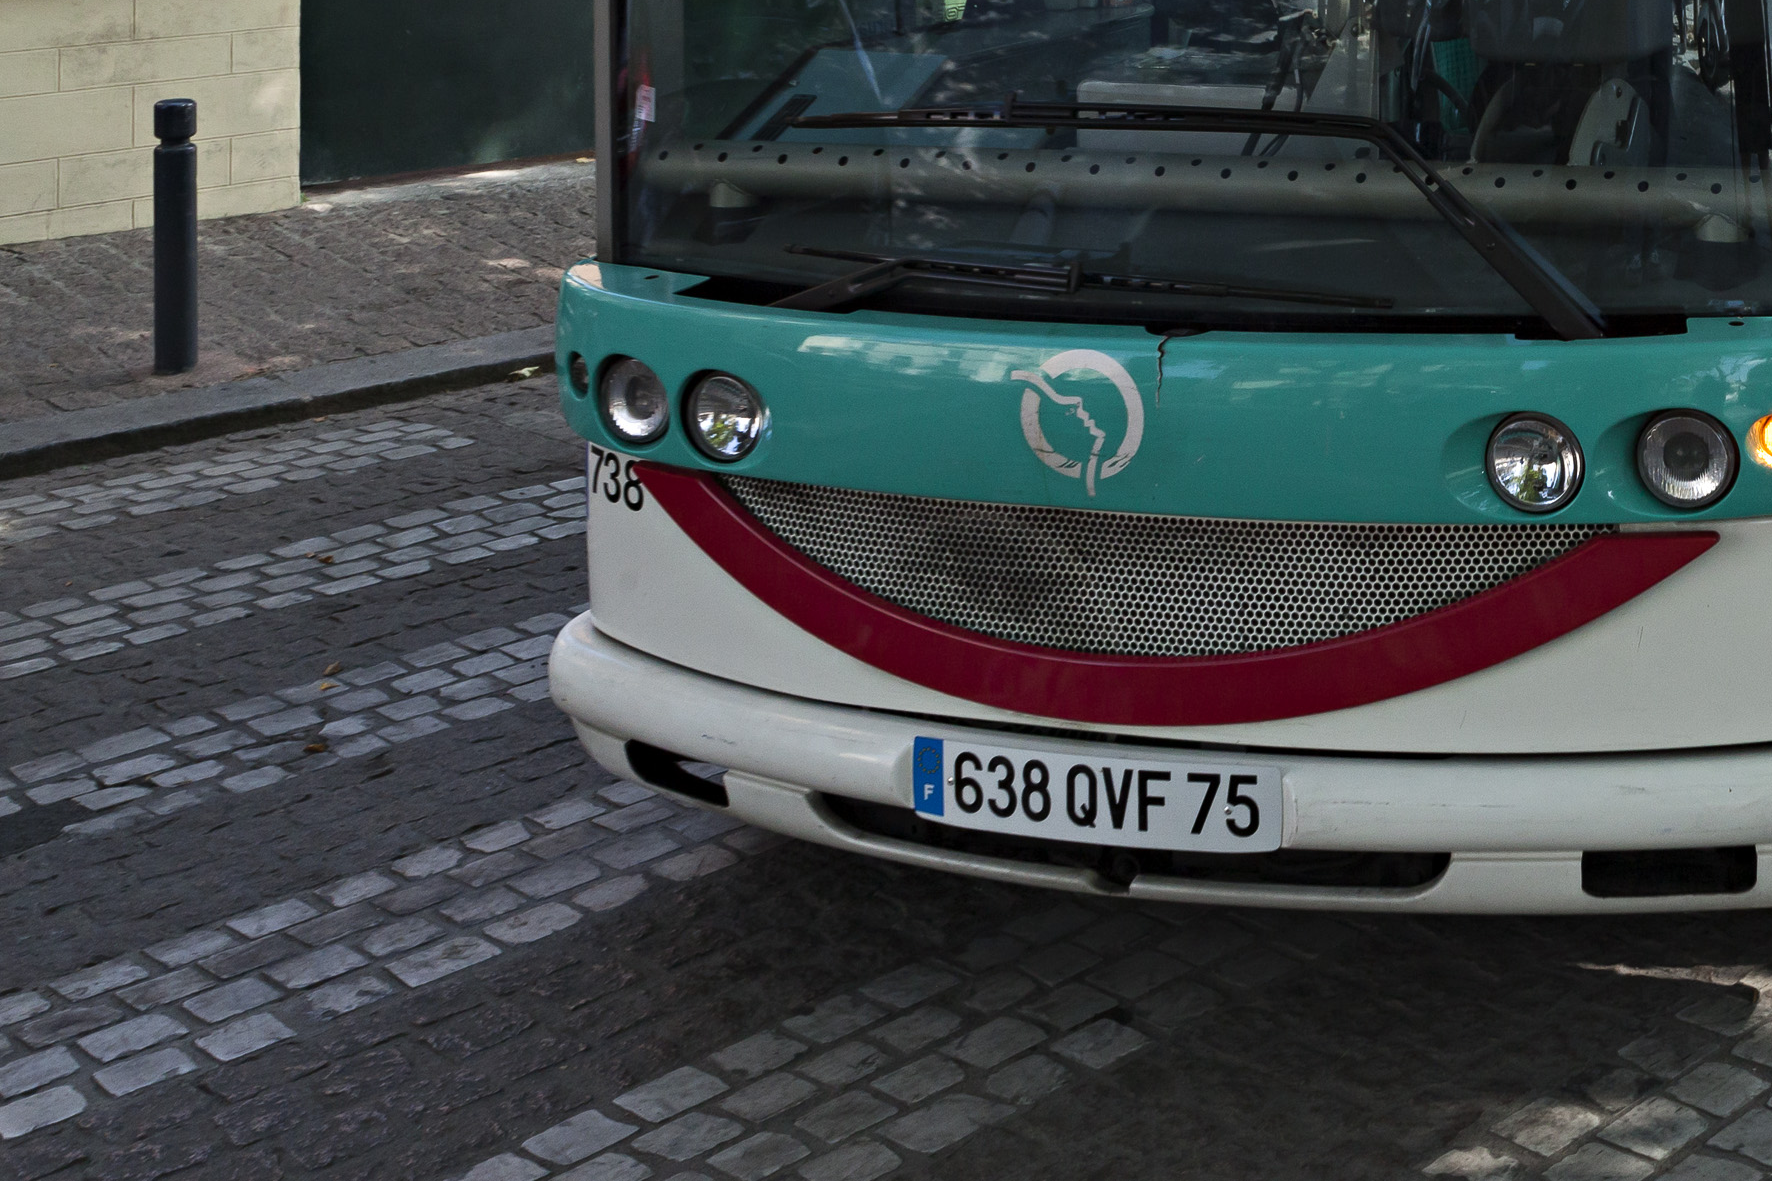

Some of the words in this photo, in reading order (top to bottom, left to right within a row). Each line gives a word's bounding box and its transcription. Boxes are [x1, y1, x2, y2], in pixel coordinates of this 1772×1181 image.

[591, 444, 644, 511] 738
[923, 783, 934, 801] F
[954, 751, 1051, 822] 638
[1065, 763, 1171, 833] QVF
[1187, 772, 1260, 838] 75
